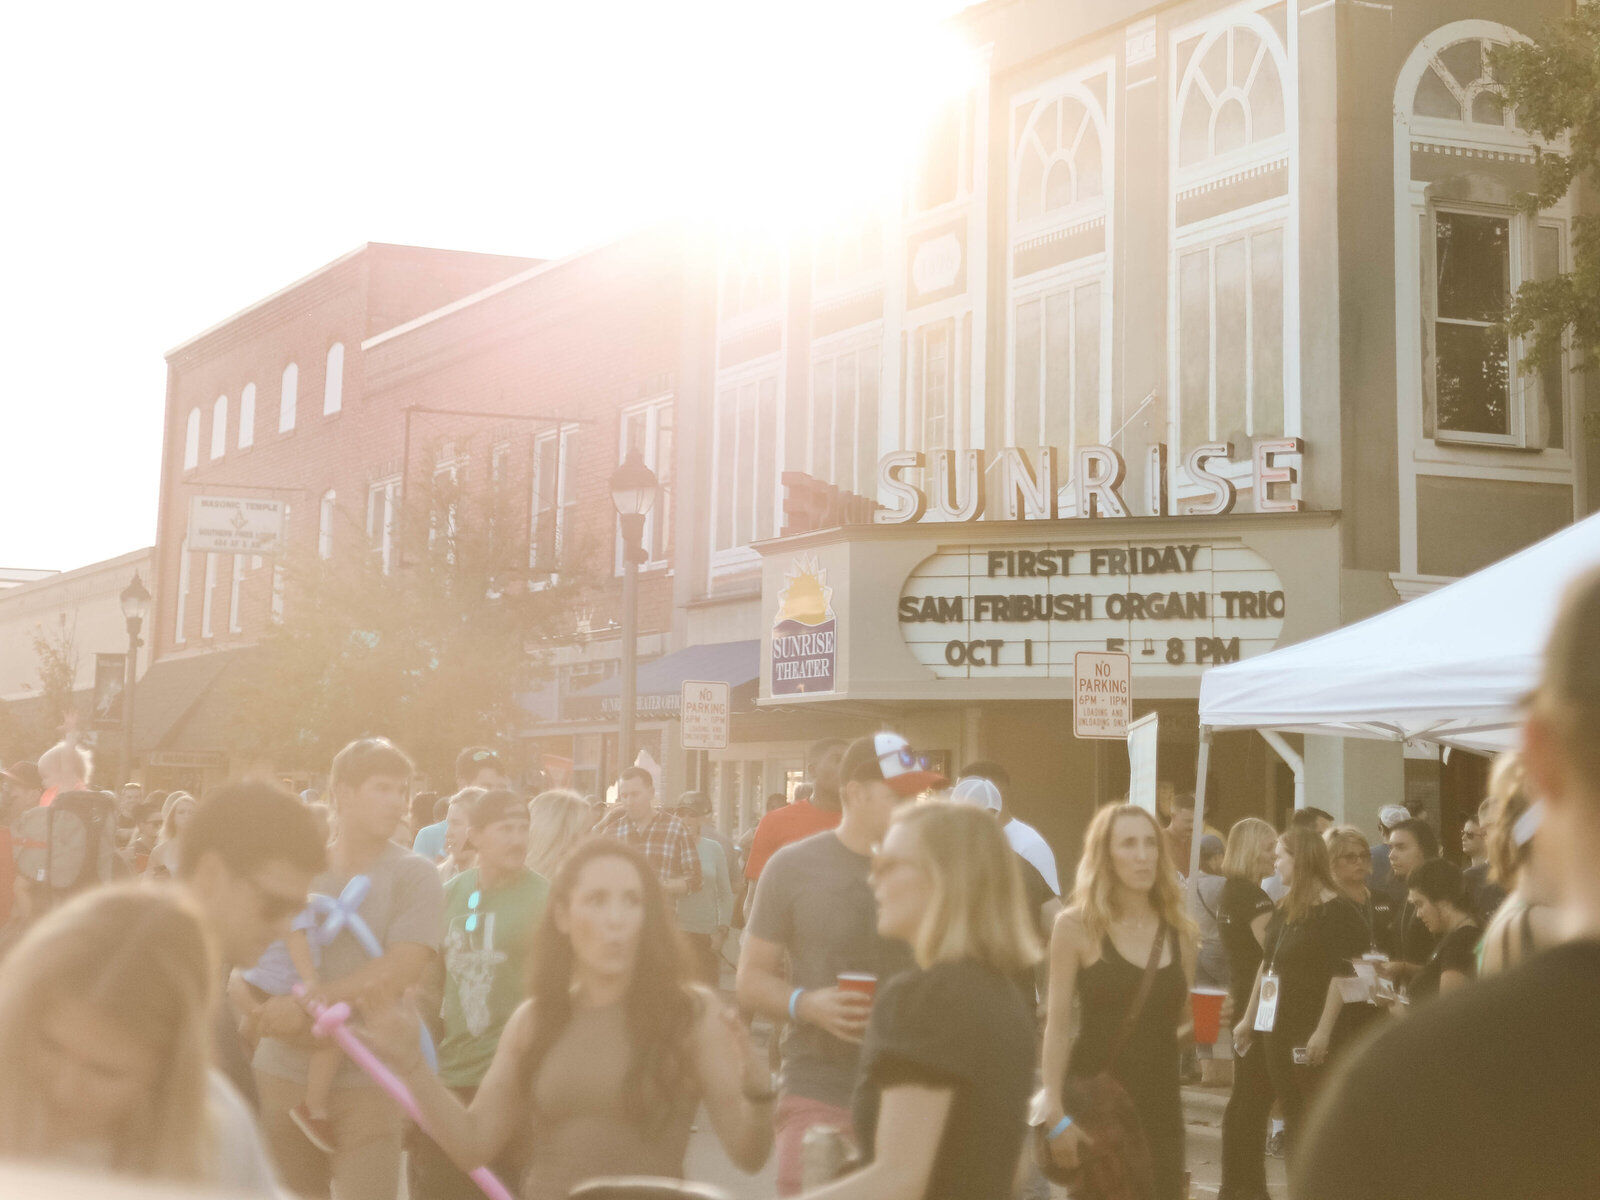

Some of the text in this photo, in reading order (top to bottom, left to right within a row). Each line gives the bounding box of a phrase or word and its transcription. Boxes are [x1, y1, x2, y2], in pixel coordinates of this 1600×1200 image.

[874, 437, 1304, 524] SUNRISE
[201, 500, 277, 511] MASONIC TEMPLE
[987, 545, 1200, 578] FIRST FRIDAY
[899, 590, 1285, 623] SAM FRIBUSH ORGAN TRIO
[773, 632, 834, 659] SUNRISE
[945, 639, 1004, 667] OCT
[1166, 637, 1185, 665] 8
[1195, 637, 1240, 665] PM
[776, 658, 830, 681] THEATER
[1095, 663, 1111, 677] NO
[1079, 679, 1127, 694] PARKING
[699, 690, 712, 701] NO
[1079, 695, 1097, 705] 6PM
[1110, 696, 1127, 706] 11PM
[686, 702, 725, 715] PARKING
[1112, 709, 1123, 717] AND
